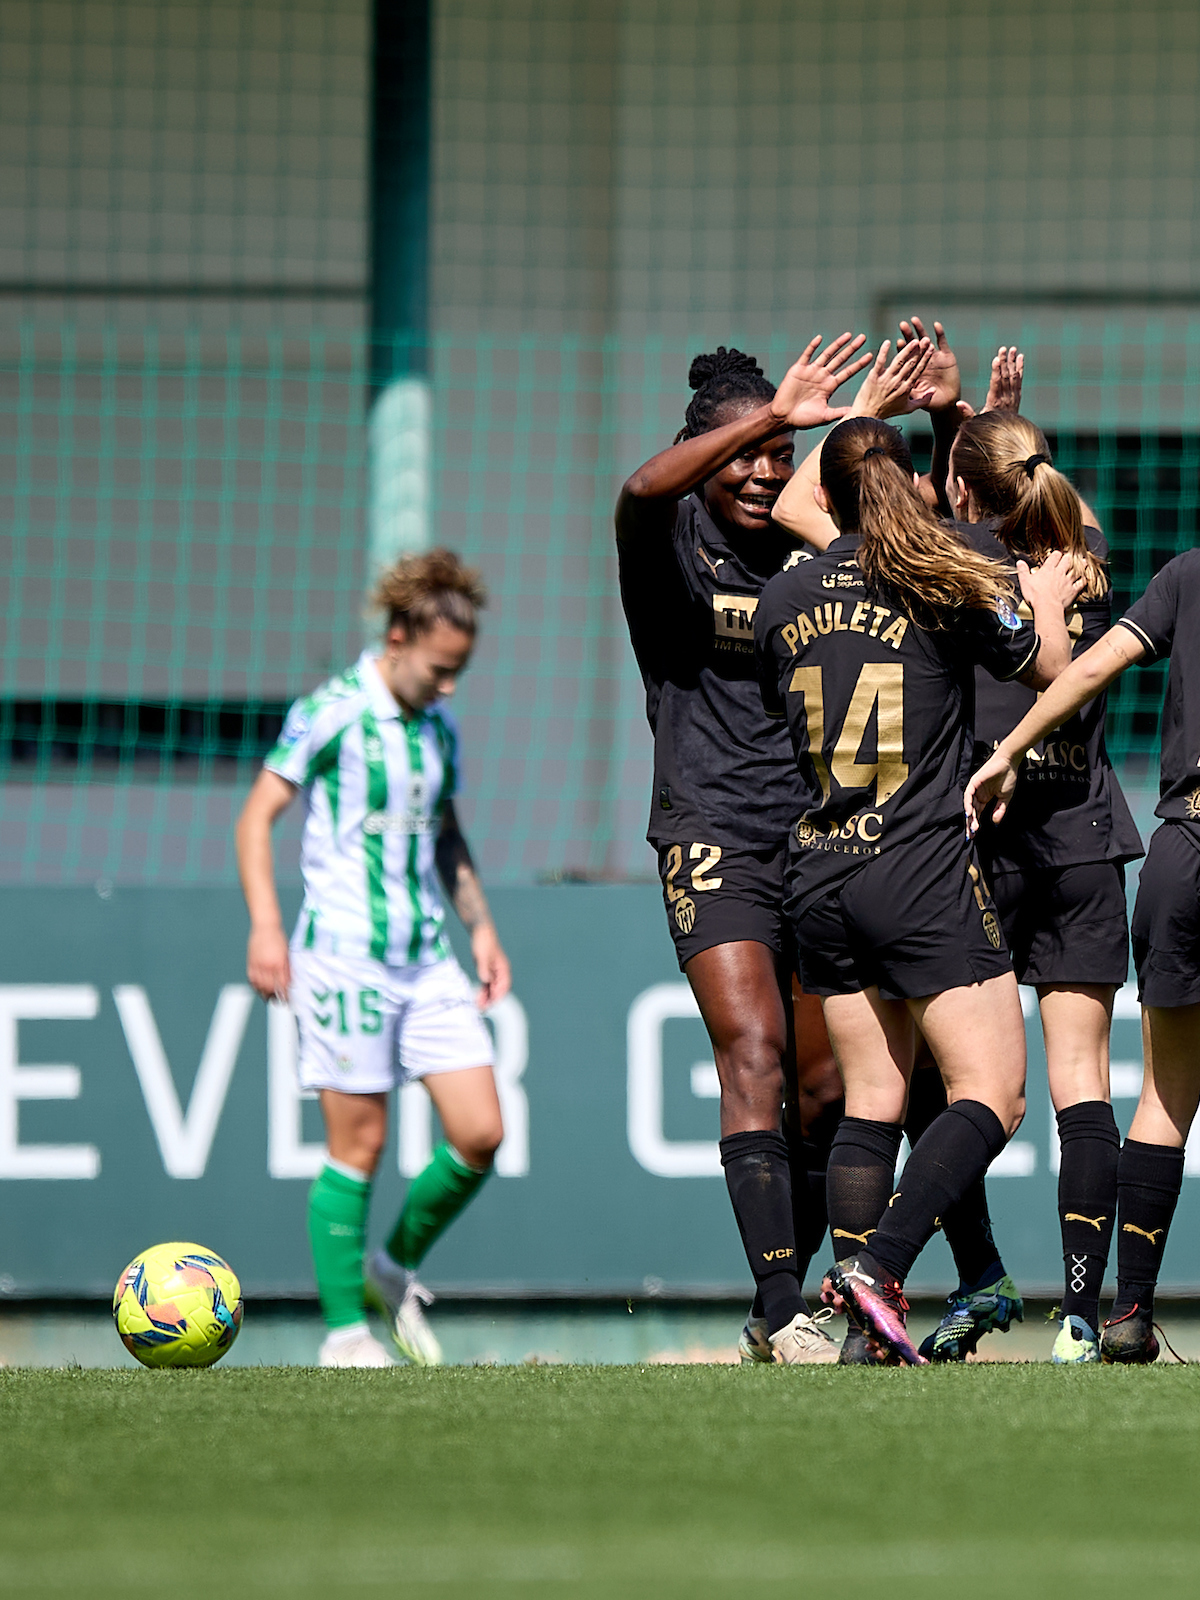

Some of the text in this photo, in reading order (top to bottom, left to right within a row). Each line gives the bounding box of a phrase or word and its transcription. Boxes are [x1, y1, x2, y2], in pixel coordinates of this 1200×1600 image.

[734, 643, 754, 654] Rea
[780, 601, 909, 656] PAULETA
[788, 662, 909, 808] 14
[1025, 741, 1087, 771] MSC
[666, 842, 723, 903] 22
[336, 988, 384, 1035] 15
[763, 1248, 794, 1262] VCF
